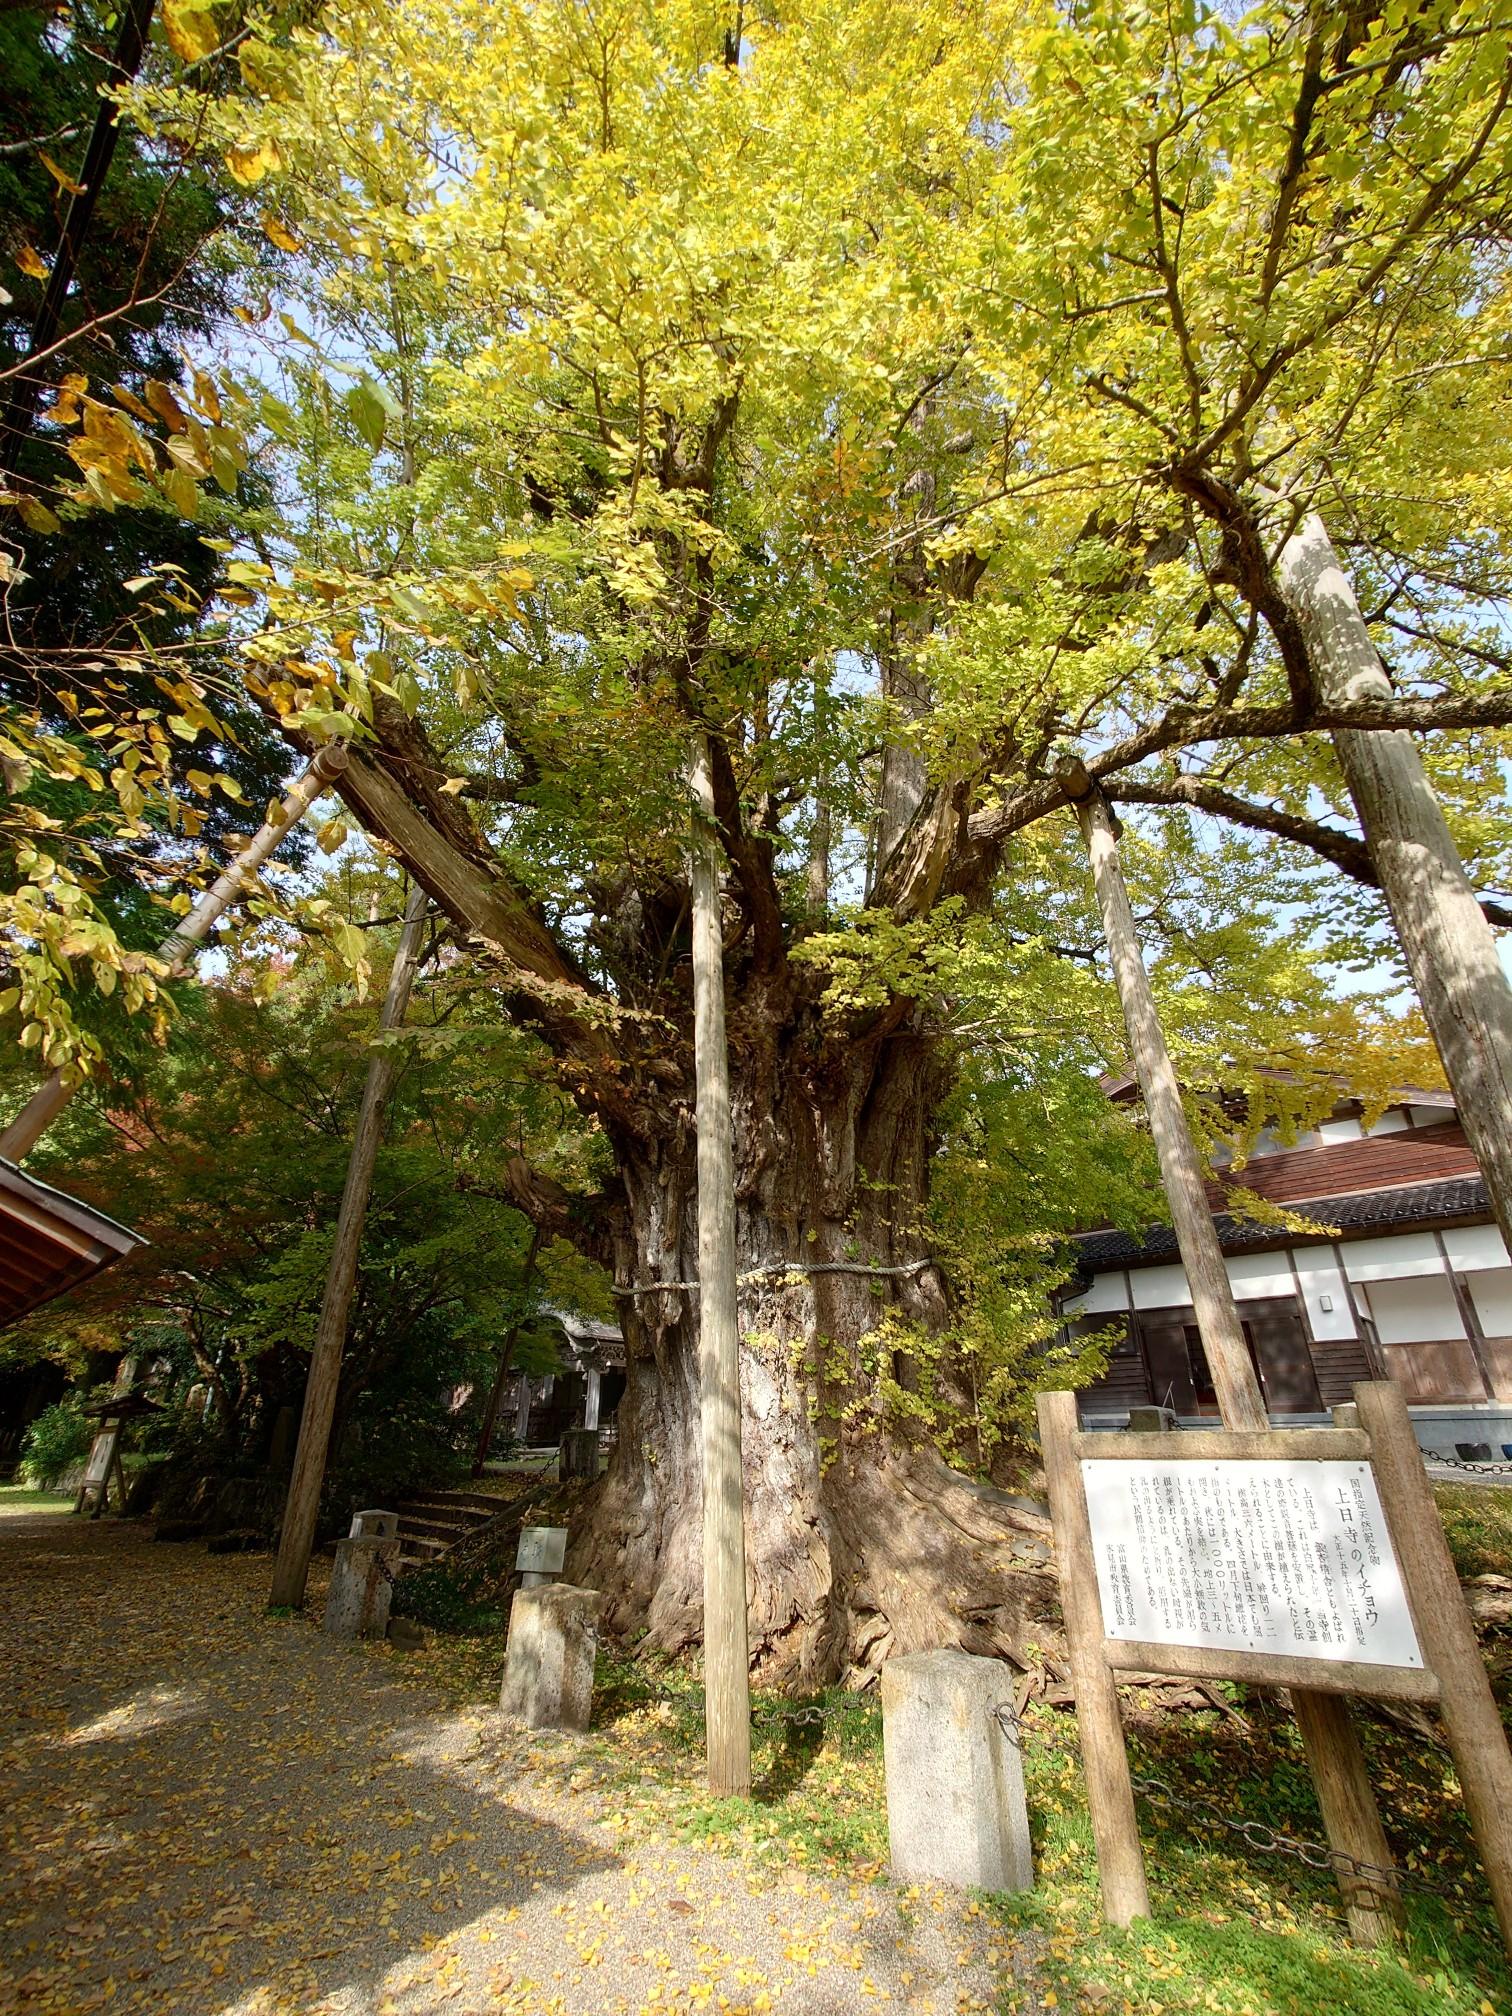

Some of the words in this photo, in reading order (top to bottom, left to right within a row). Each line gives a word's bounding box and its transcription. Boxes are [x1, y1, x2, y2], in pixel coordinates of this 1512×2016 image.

[1331, 1487, 1382, 1628] 上日寺のイチョウ
[1348, 1478, 1381, 1565] 国指定天然記念物
[1105, 1543, 1125, 1626] 氷見市教育委員会
[1116, 1543, 1137, 1626] 富山県教育委員会
